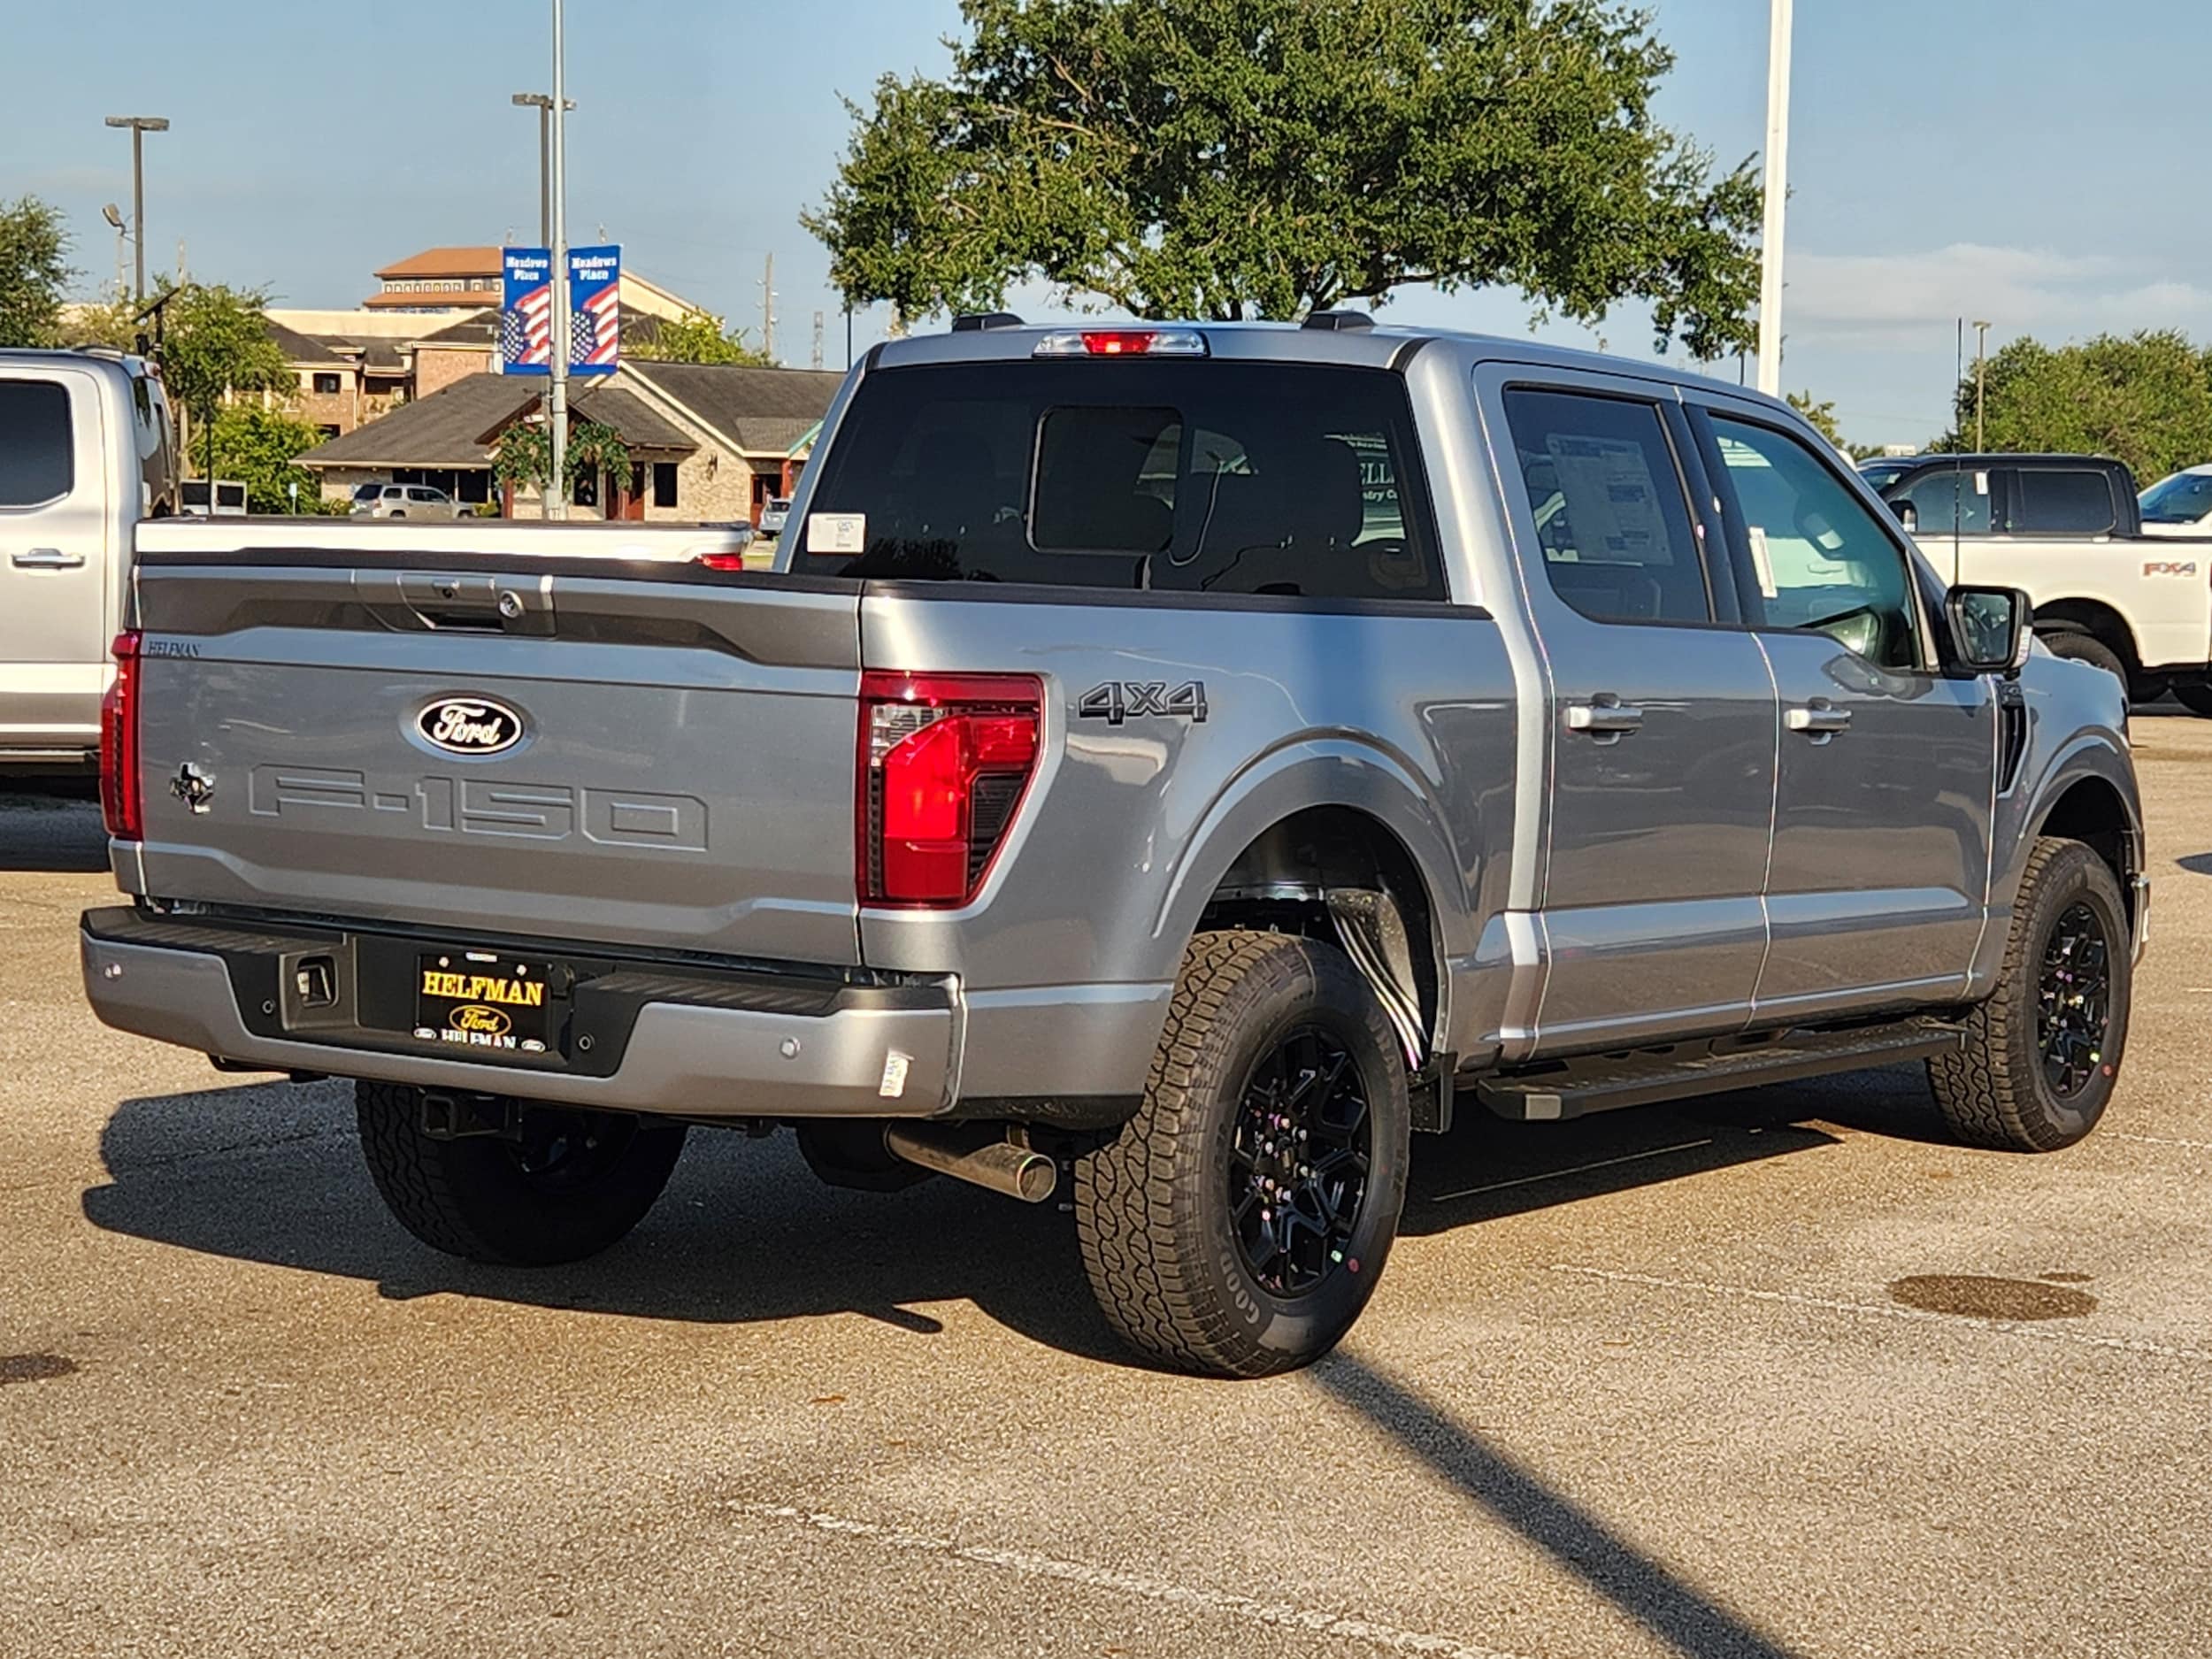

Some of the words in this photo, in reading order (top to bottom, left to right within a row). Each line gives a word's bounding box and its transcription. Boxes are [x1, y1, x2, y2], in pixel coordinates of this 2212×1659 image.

[505, 256, 549, 268] Meadows
[571, 256, 618, 269] Meadows
[513, 269, 540, 280] Place
[580, 269, 609, 280] Place
[2143, 562, 2196, 577] FX4
[148, 641, 200, 657] HELFMAN
[433, 703, 503, 745] Ford
[248, 764, 708, 852] F-150
[422, 971, 544, 1006] HELFMAN
[460, 1008, 500, 1032] Ford
[441, 1029, 517, 1049] HELFMAN
